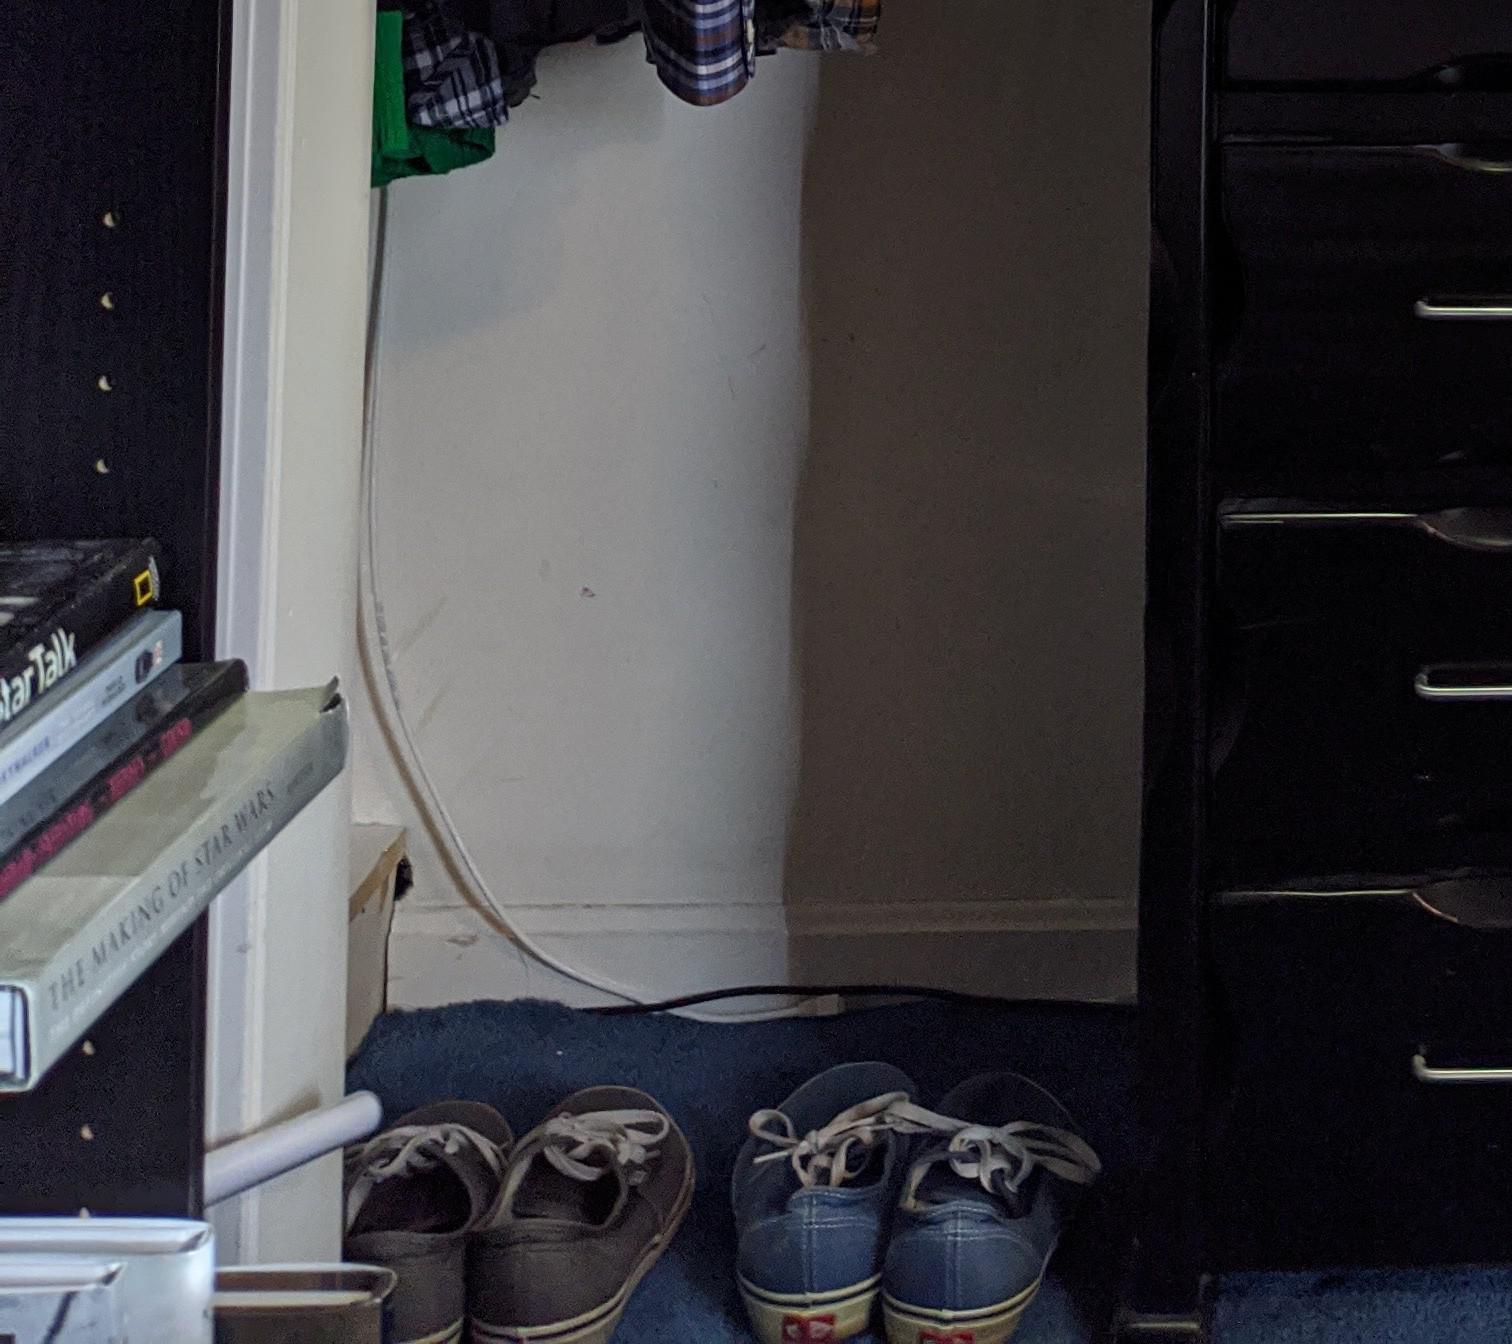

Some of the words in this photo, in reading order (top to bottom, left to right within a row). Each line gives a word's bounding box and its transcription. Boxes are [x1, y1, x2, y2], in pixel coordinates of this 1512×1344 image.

[0, 628, 77, 721] tarTalk
[48, 961, 85, 1010] THE
[91, 887, 162, 964] MAKING
[168, 864, 191, 898] OF
[195, 824, 233, 867] STAR
[234, 780, 275, 831] WARS
